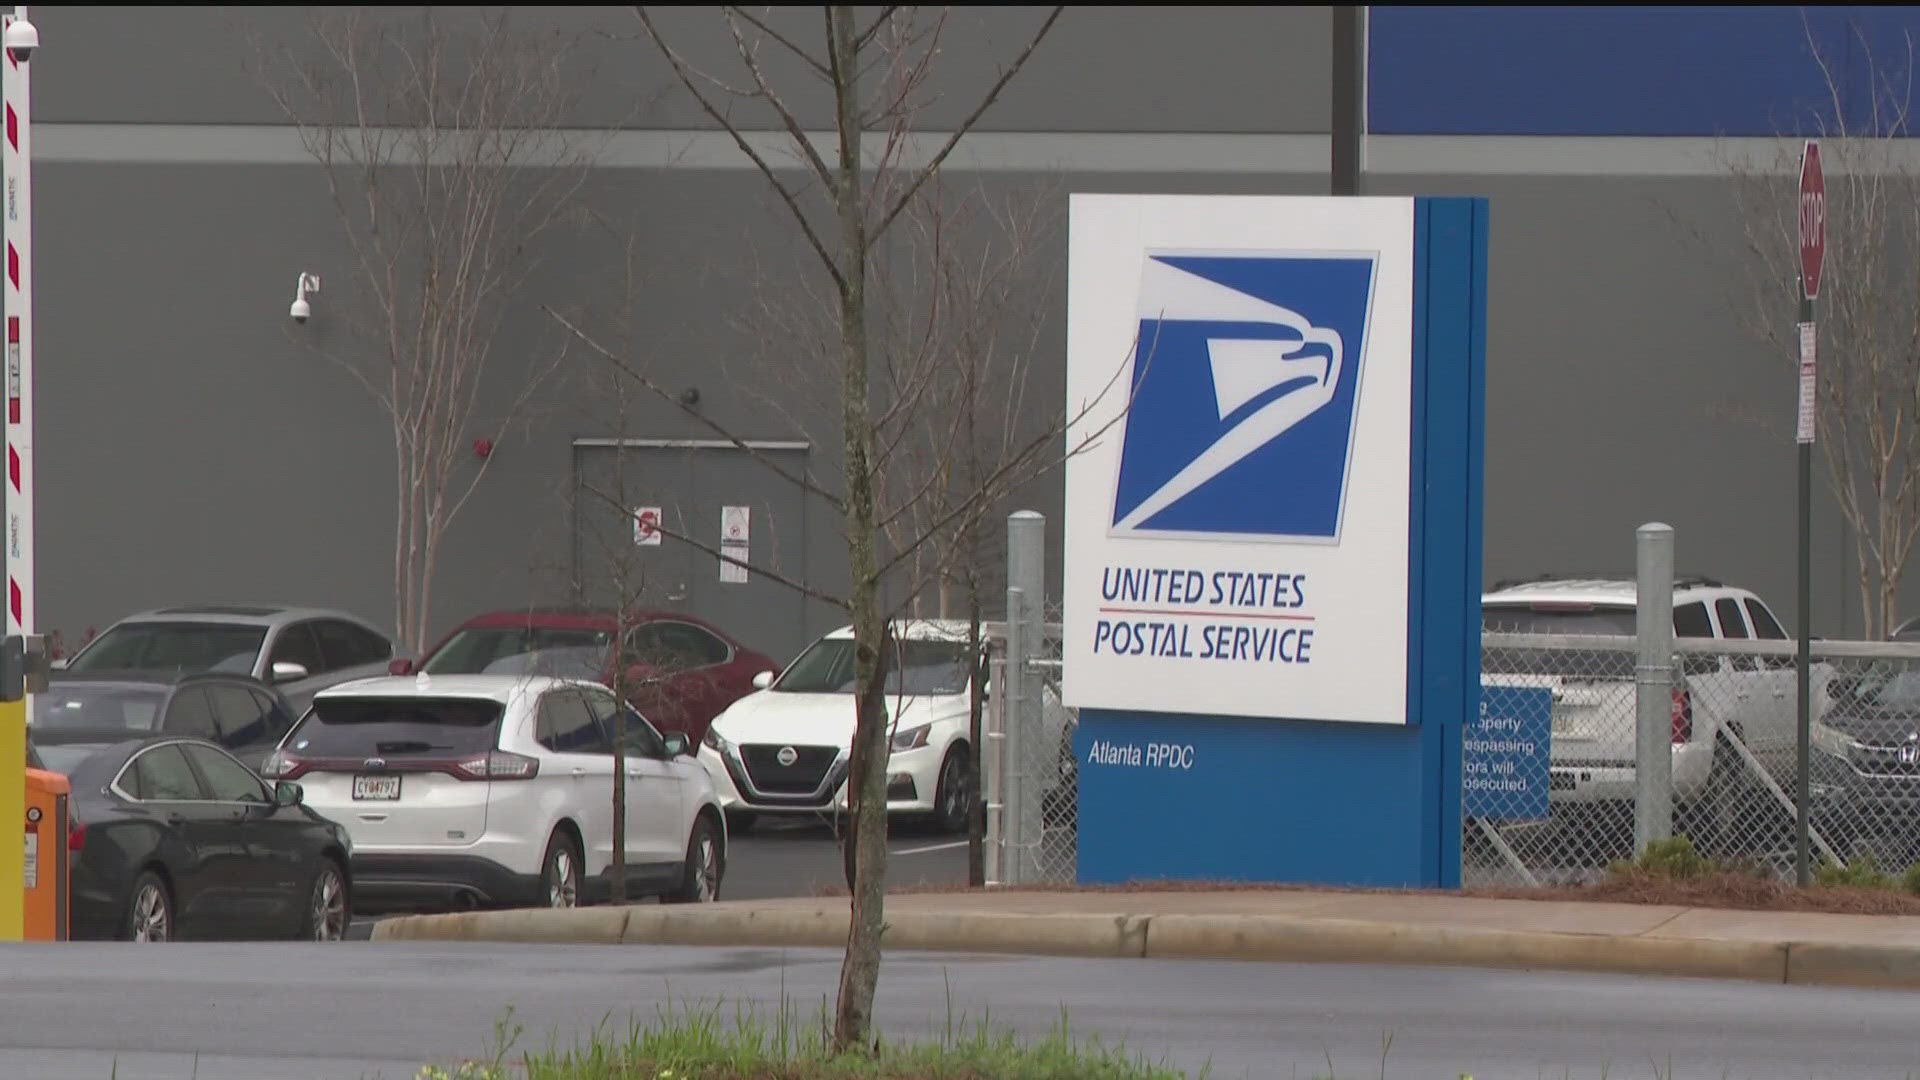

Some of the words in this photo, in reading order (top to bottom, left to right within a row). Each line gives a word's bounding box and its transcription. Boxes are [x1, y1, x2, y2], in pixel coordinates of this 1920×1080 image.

[1801, 192, 1823, 248] STOP
[1102, 567, 1204, 604] UNITED
[1209, 571, 1305, 608] STATES
[1094, 620, 1193, 658] POSTAL
[1200, 625, 1313, 663] SERVICE
[1471, 717, 1521, 732] operty
[1088, 740, 1141, 766] Atlanta
[1146, 743, 1194, 769] RPDC
[1464, 739, 1535, 756] espassing
[1492, 761, 1514, 775] will
[1464, 777, 1527, 792] osecuted
